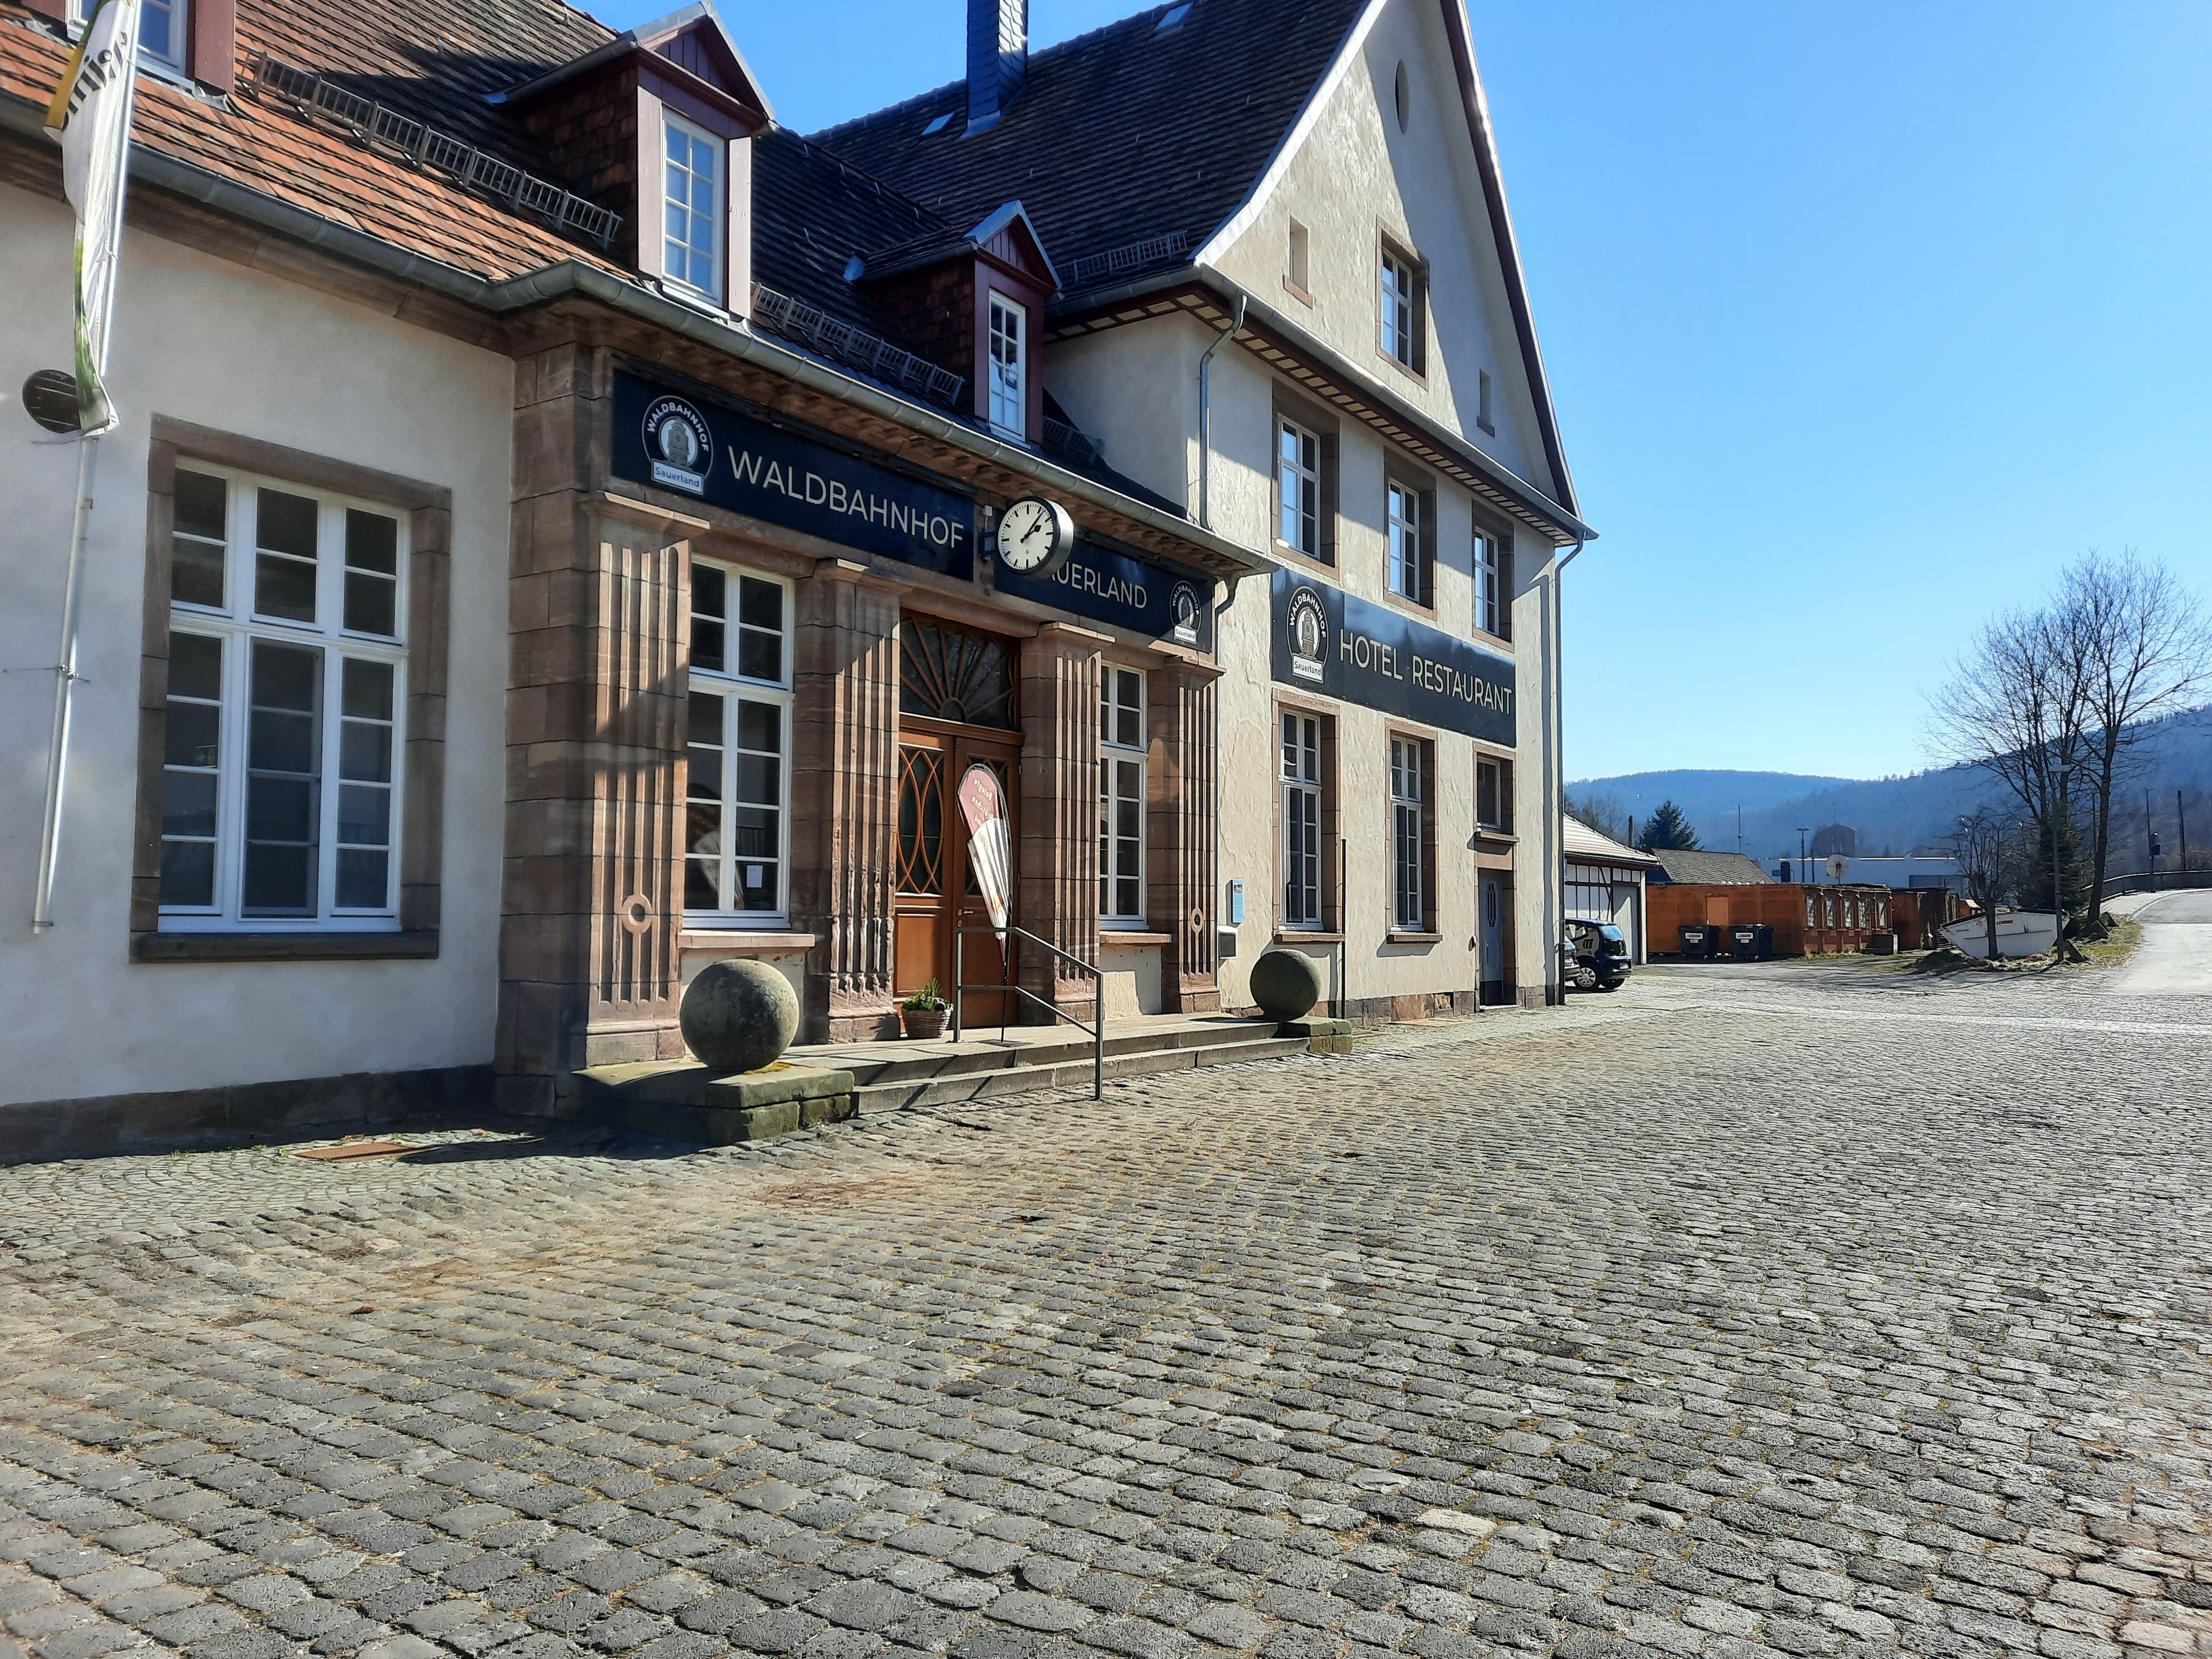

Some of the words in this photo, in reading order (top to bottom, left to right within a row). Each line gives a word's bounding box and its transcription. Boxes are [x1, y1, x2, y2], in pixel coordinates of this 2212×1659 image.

[646, 402, 709, 452] WALDBAHNHOF
[654, 466, 700, 488] Sauerland
[728, 445, 964, 548] WALDBAHNHOF
[1052, 560, 1147, 609] UERLAND
[1289, 592, 1327, 639] WALDBAHNHOF
[1294, 660, 1322, 676] Sauerland
[1340, 628, 1404, 681] HOTEL
[1412, 654, 1512, 715] RESTAURANT
